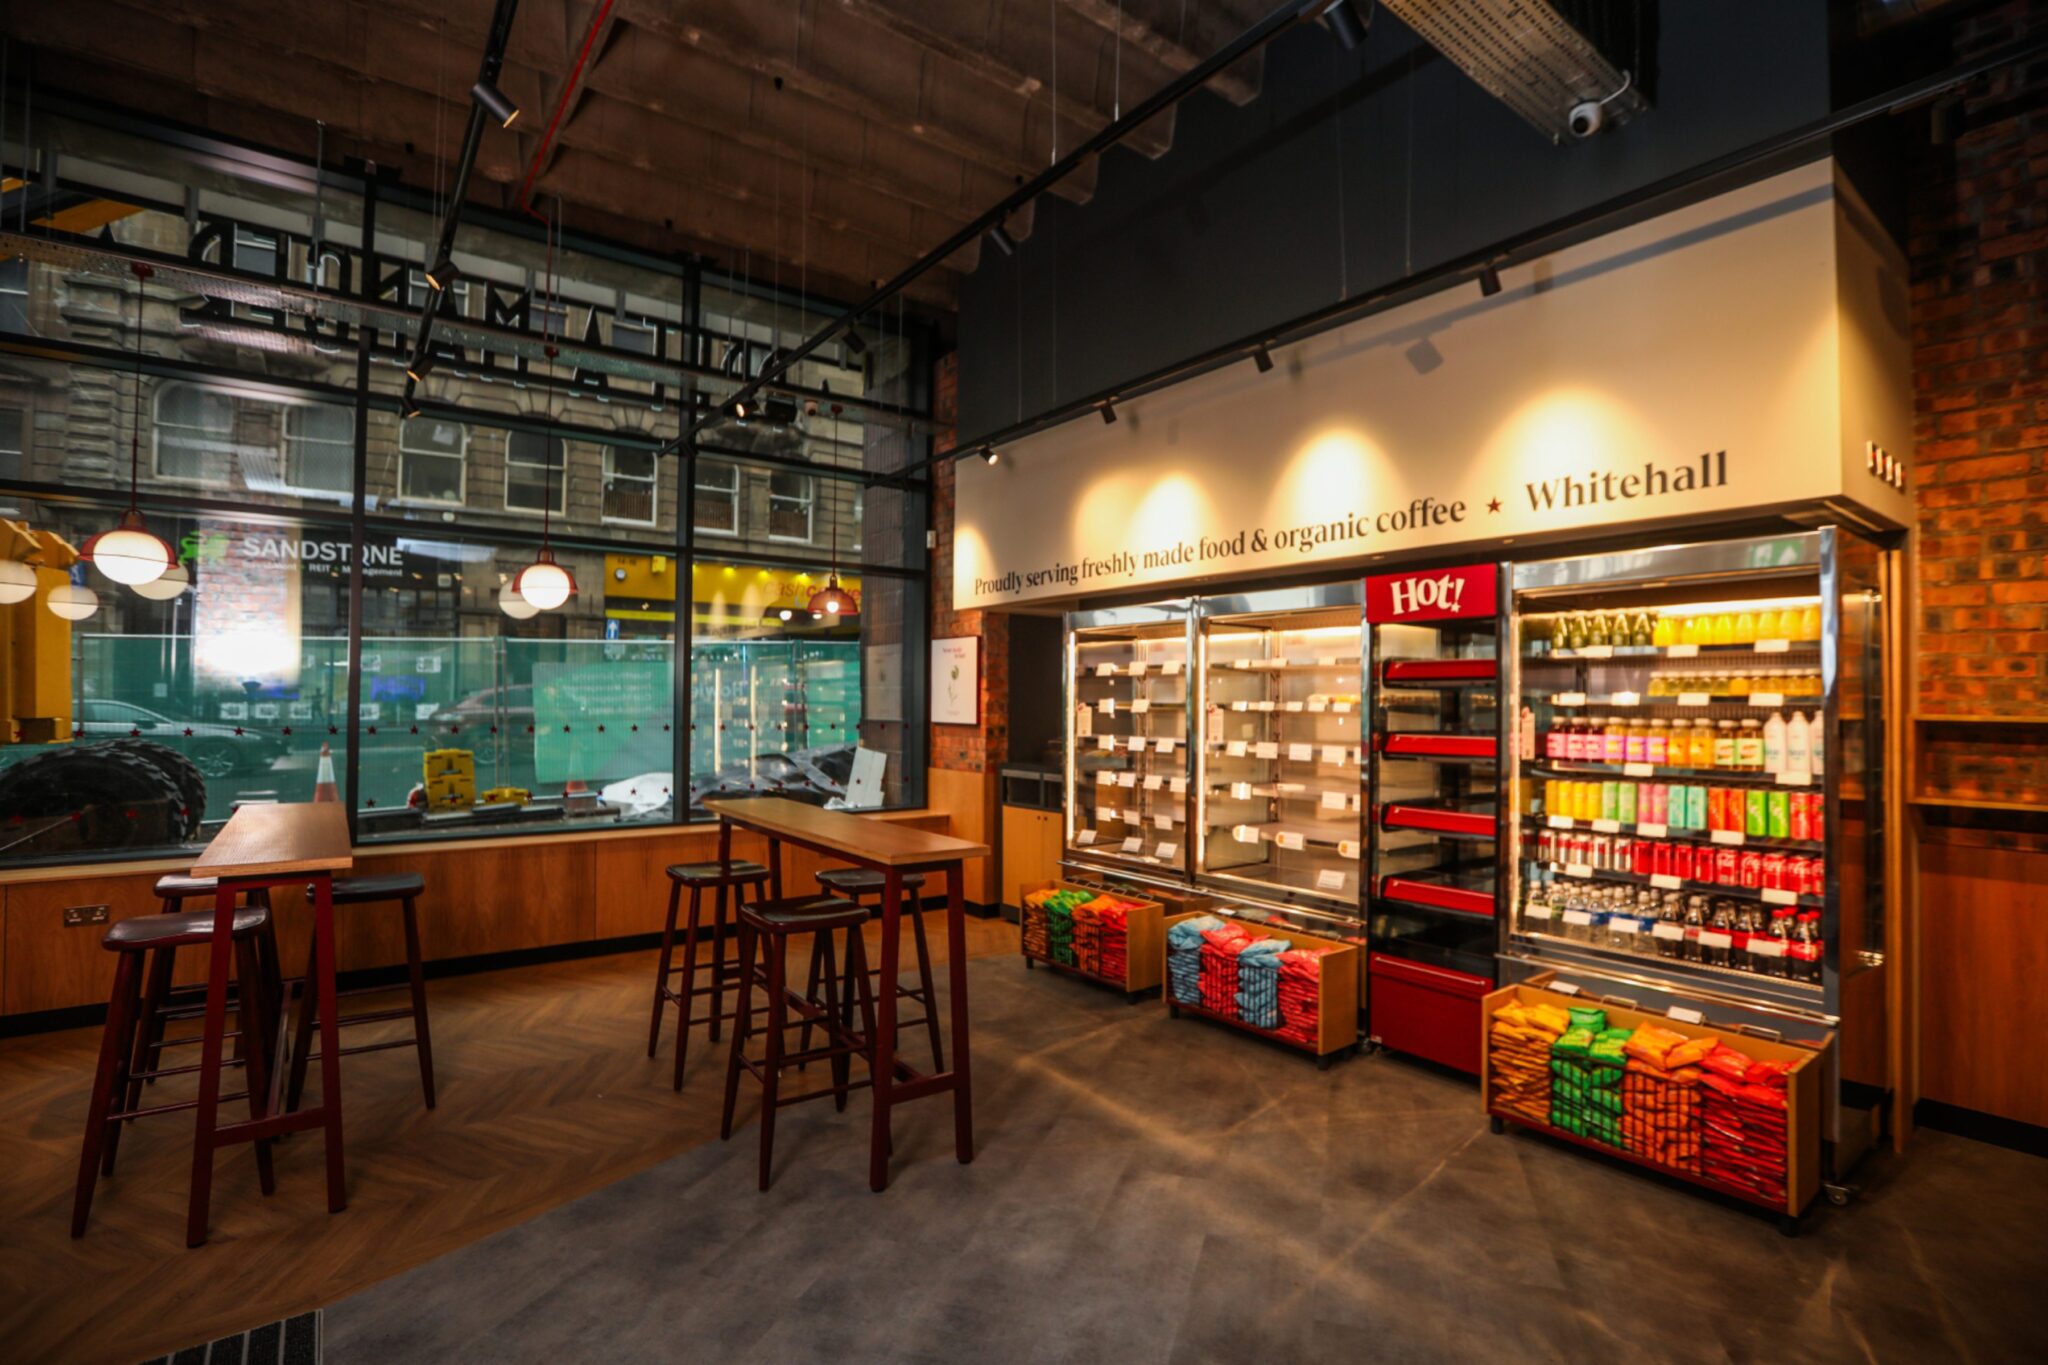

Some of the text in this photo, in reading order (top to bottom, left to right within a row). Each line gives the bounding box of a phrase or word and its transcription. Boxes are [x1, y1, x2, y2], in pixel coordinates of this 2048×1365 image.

[974, 450, 1728, 596] Proudly serving freshly made food & organic coffee Whitehall
[243, 538, 404, 566] SANDSTNE
[309, 563, 330, 573] REIT
[342, 564, 402, 577] Magement
